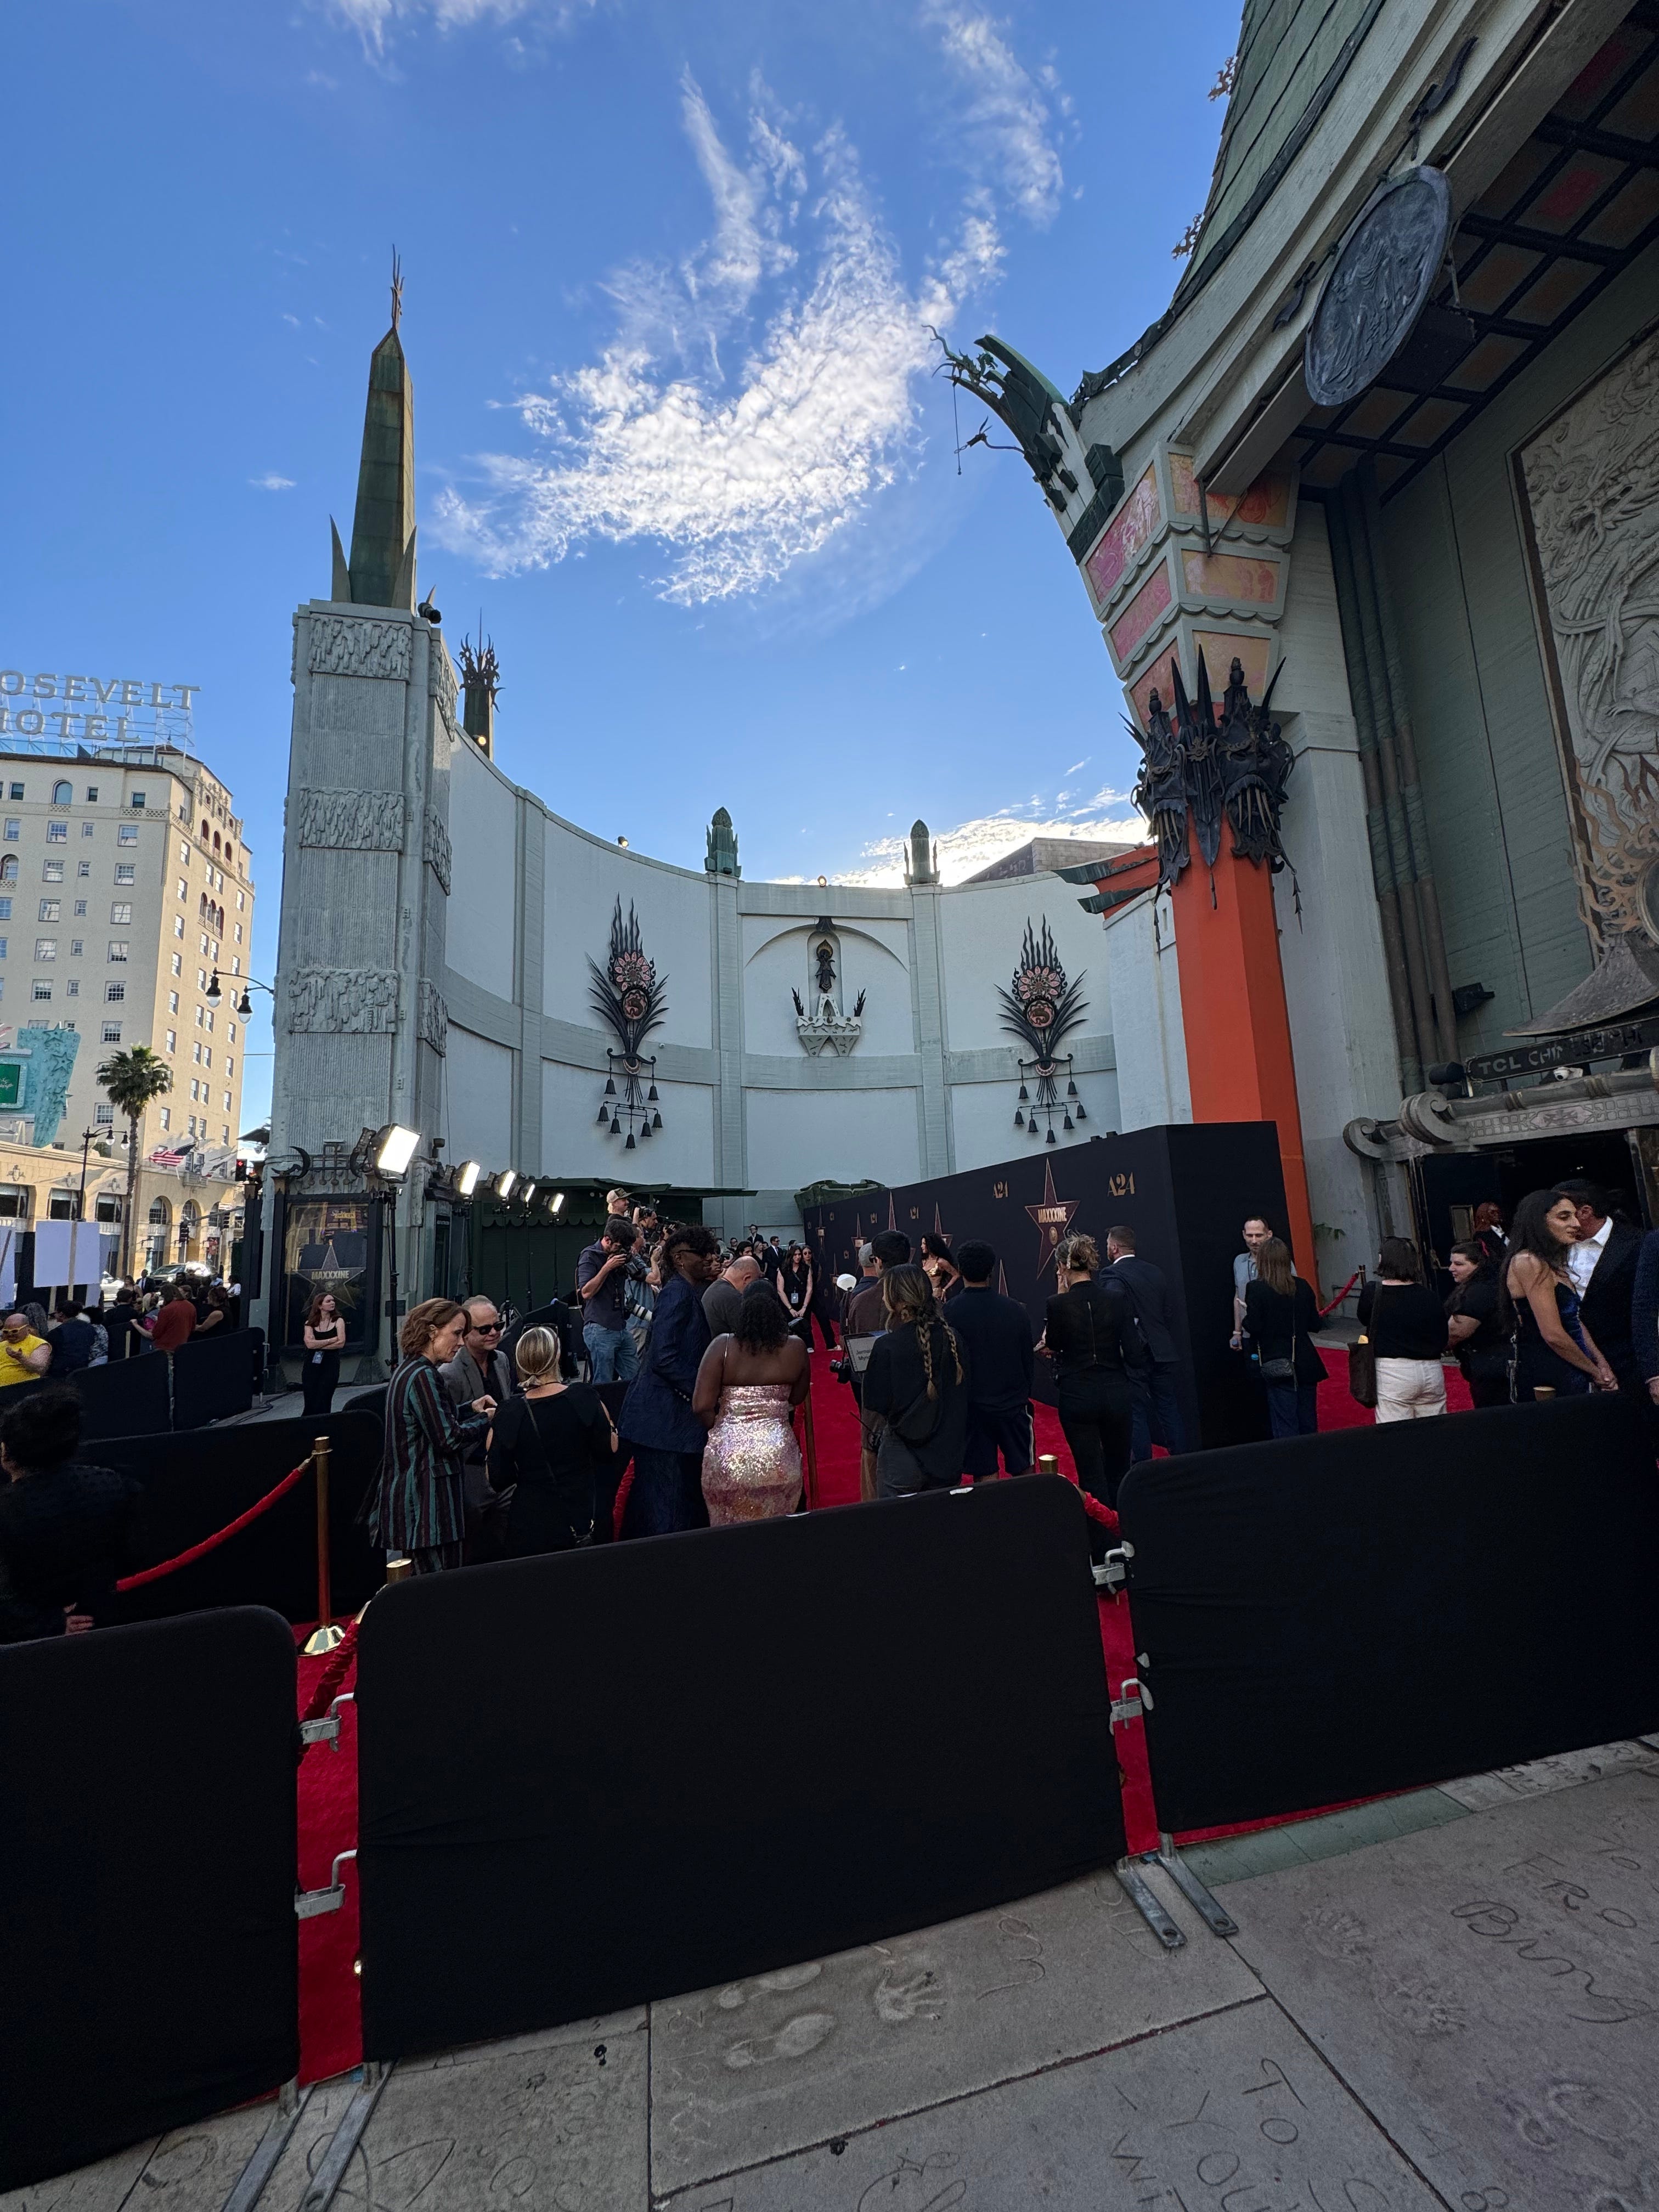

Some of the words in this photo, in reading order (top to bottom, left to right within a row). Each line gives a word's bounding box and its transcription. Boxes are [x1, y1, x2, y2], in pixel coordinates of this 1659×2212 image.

[1479, 1056, 1521, 1074] TCL
[992, 1180, 1008, 1199] A24
[1107, 1171, 1135, 1197] A24
[1037, 1207, 1067, 1223] MAXXXINE
[311, 1270, 349, 1280] MAXXXINE
[1503, 1851, 1659, 1945] FRO
